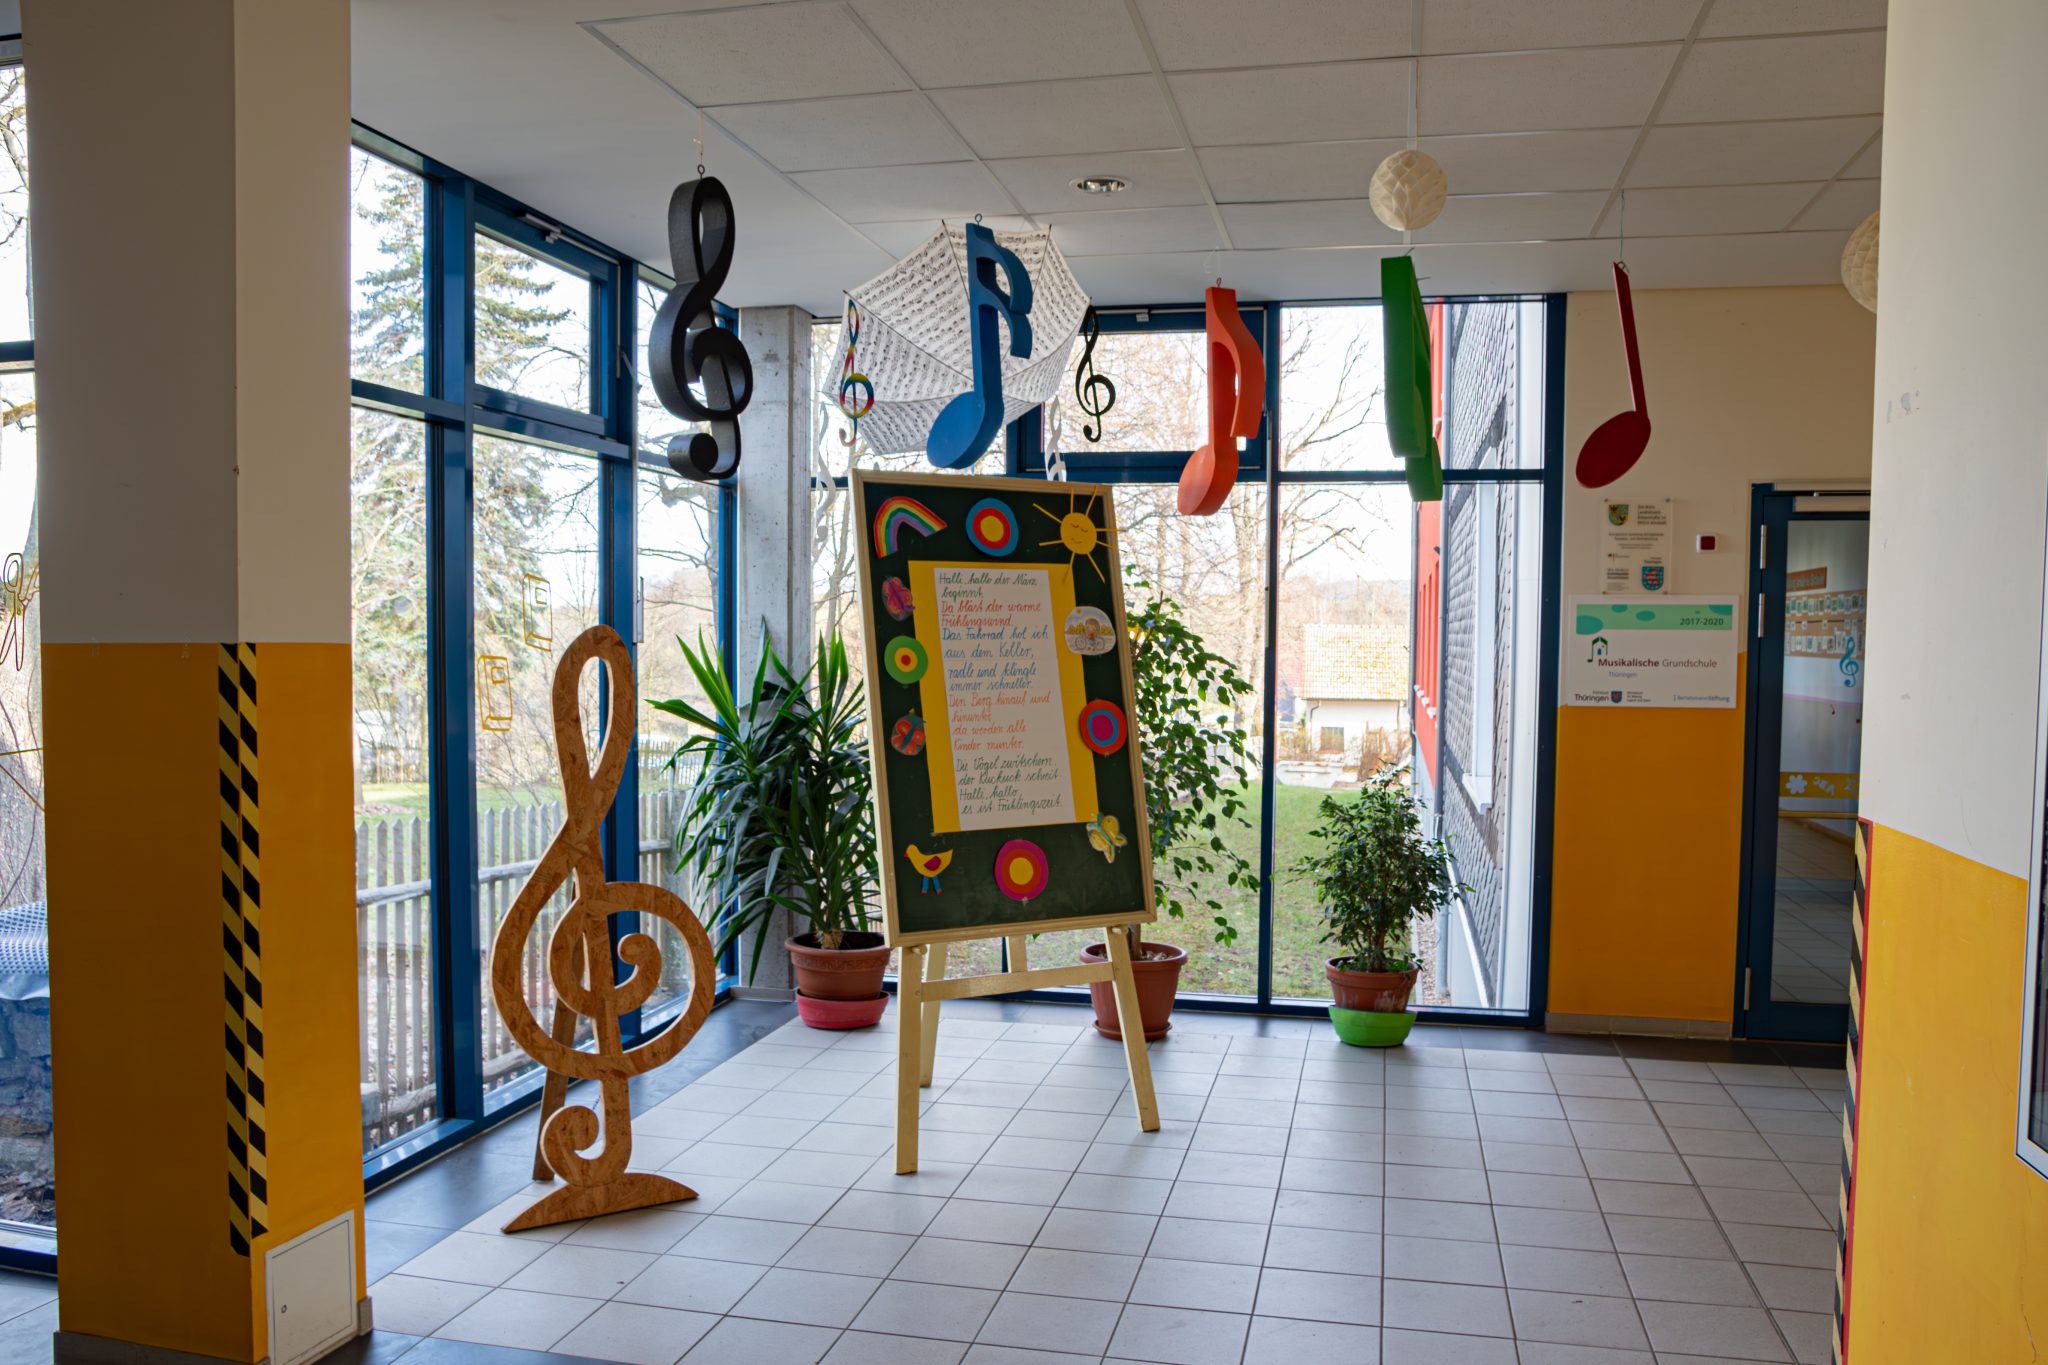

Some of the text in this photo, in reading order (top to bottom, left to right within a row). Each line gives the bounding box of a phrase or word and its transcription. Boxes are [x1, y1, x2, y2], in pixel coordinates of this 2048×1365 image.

[994, 572, 1010, 585] der
[941, 601, 954, 613] Da
[985, 599, 1003, 612] der
[1007, 602, 1041, 612] warme
[1679, 617, 1724, 627] 2017-2020
[942, 624, 1049, 641] Das Fahrrad hol ich
[944, 641, 1034, 659] aus dem Keller,
[947, 661, 974, 679] radle
[976, 662, 998, 678] und
[1598, 657, 1718, 669] Musikalische Grundschule
[1608, 671, 1637, 680] Thüringen
[949, 681, 982, 692] immer
[949, 689, 1050, 709] Den Berg hinauf und
[1574, 693, 1609, 703] Thüringen
[952, 724, 967, 736] da
[1006, 719, 1027, 733] alle
[953, 738, 982, 752] Kinder
[956, 758, 969, 773] Die
[958, 773, 976, 787] der
[979, 768, 1022, 786] Kuckuck
[961, 804, 973, 815] es
[977, 801, 993, 814] ist
